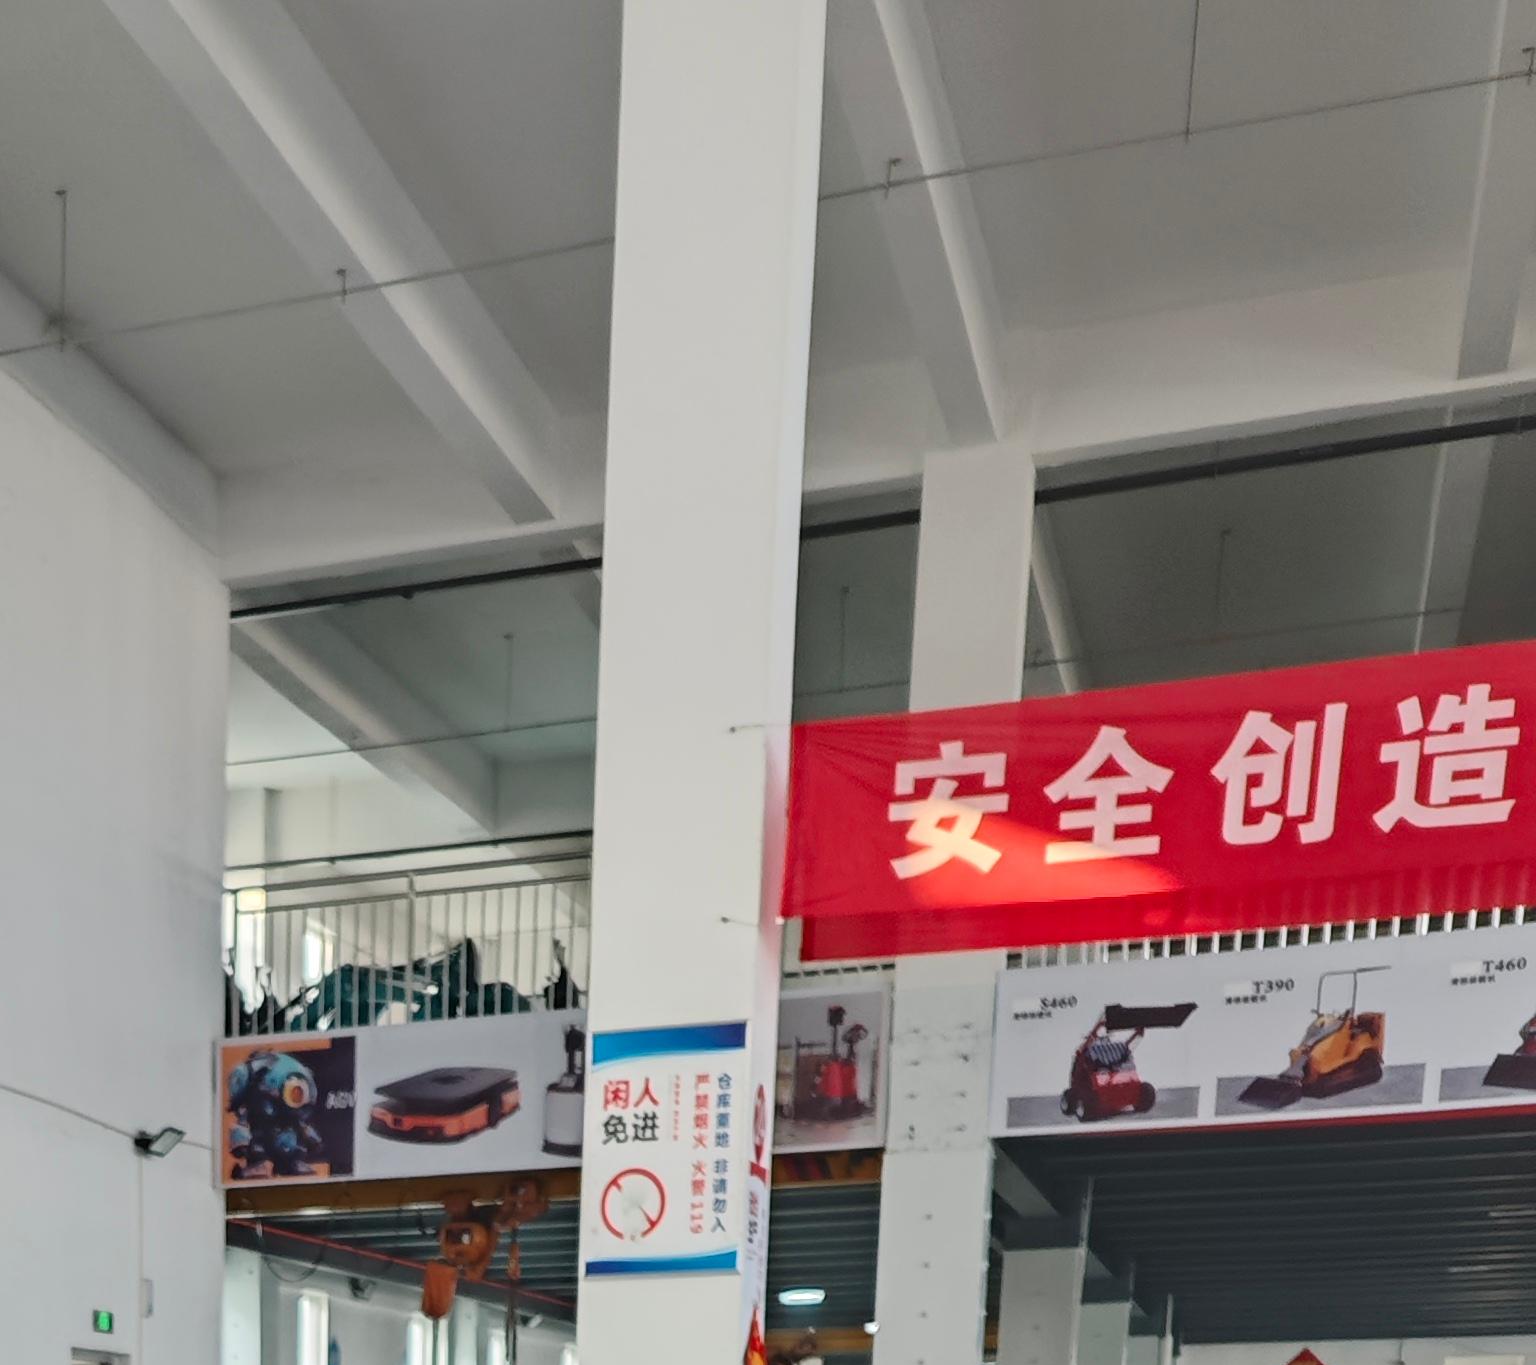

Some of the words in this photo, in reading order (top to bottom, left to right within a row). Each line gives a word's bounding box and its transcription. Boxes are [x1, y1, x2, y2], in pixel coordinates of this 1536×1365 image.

[886, 682, 1521, 880] 安全创造
[1482, 956, 1528, 973] T460
[1252, 978, 1295, 994] T390
[602, 1076, 661, 1111] 闲人
[601, 1111, 660, 1145] 免进
